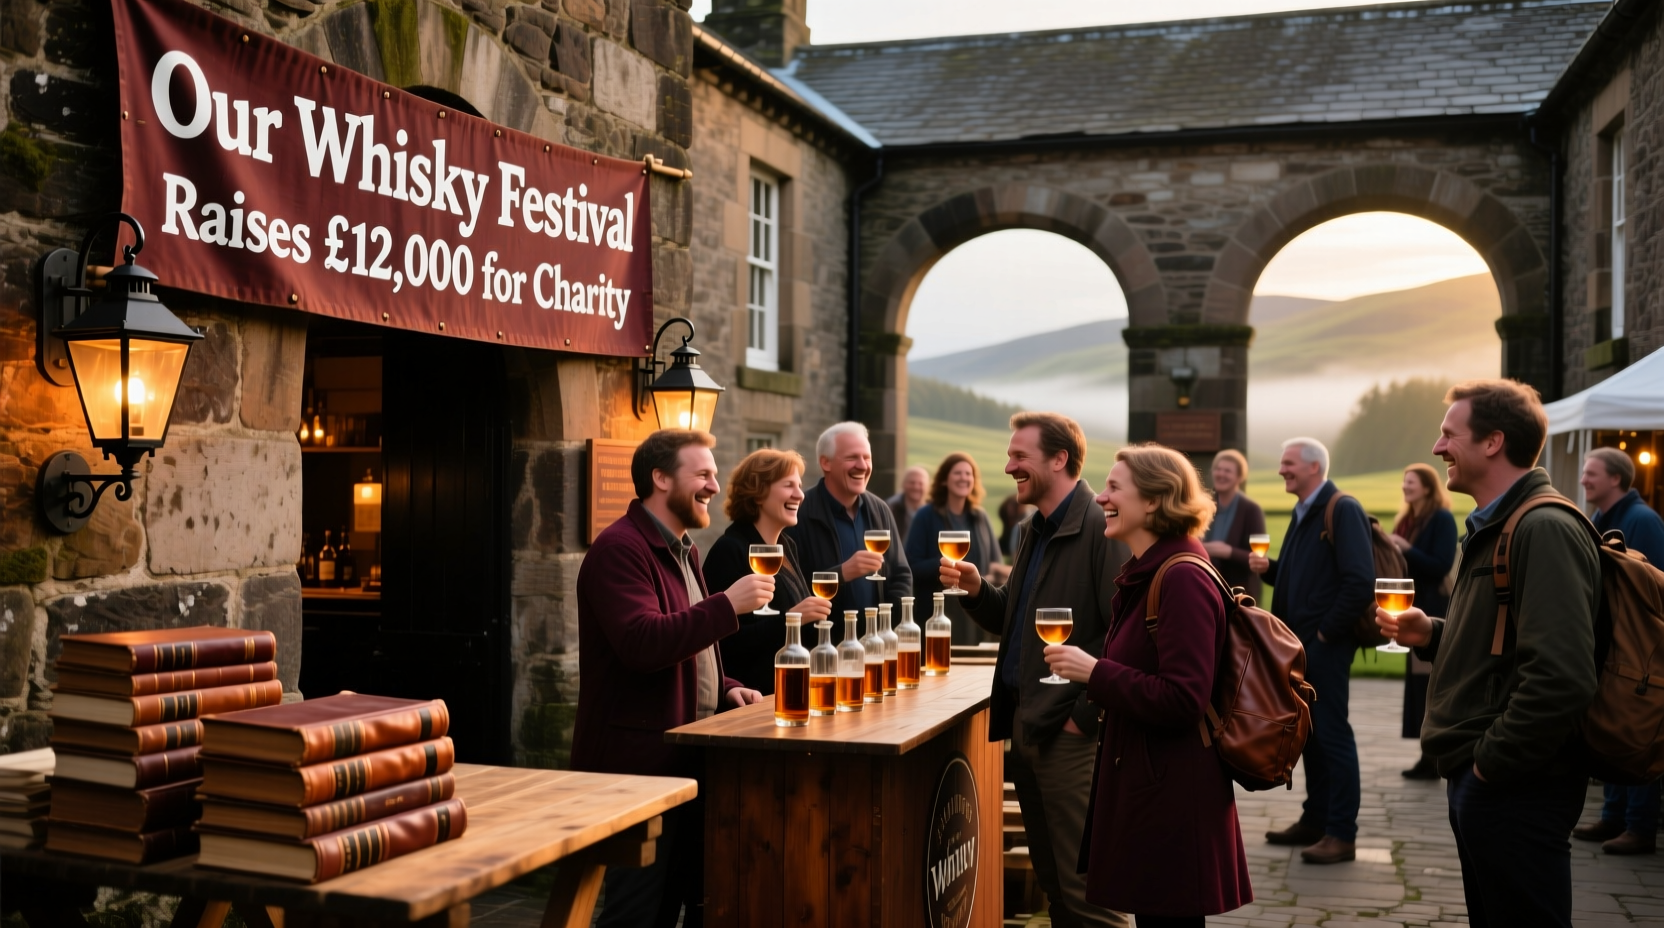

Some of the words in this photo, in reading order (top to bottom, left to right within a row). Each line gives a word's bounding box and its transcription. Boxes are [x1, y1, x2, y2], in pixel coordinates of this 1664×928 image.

[151, 50, 283, 164] Our
[293, 95, 490, 238] Whisky
[497, 160, 634, 253] Festival
[161, 172, 312, 264] Raises
[324, 214, 474, 296] £12,000
[481, 250, 528, 305] for
[533, 262, 632, 331] Charity
